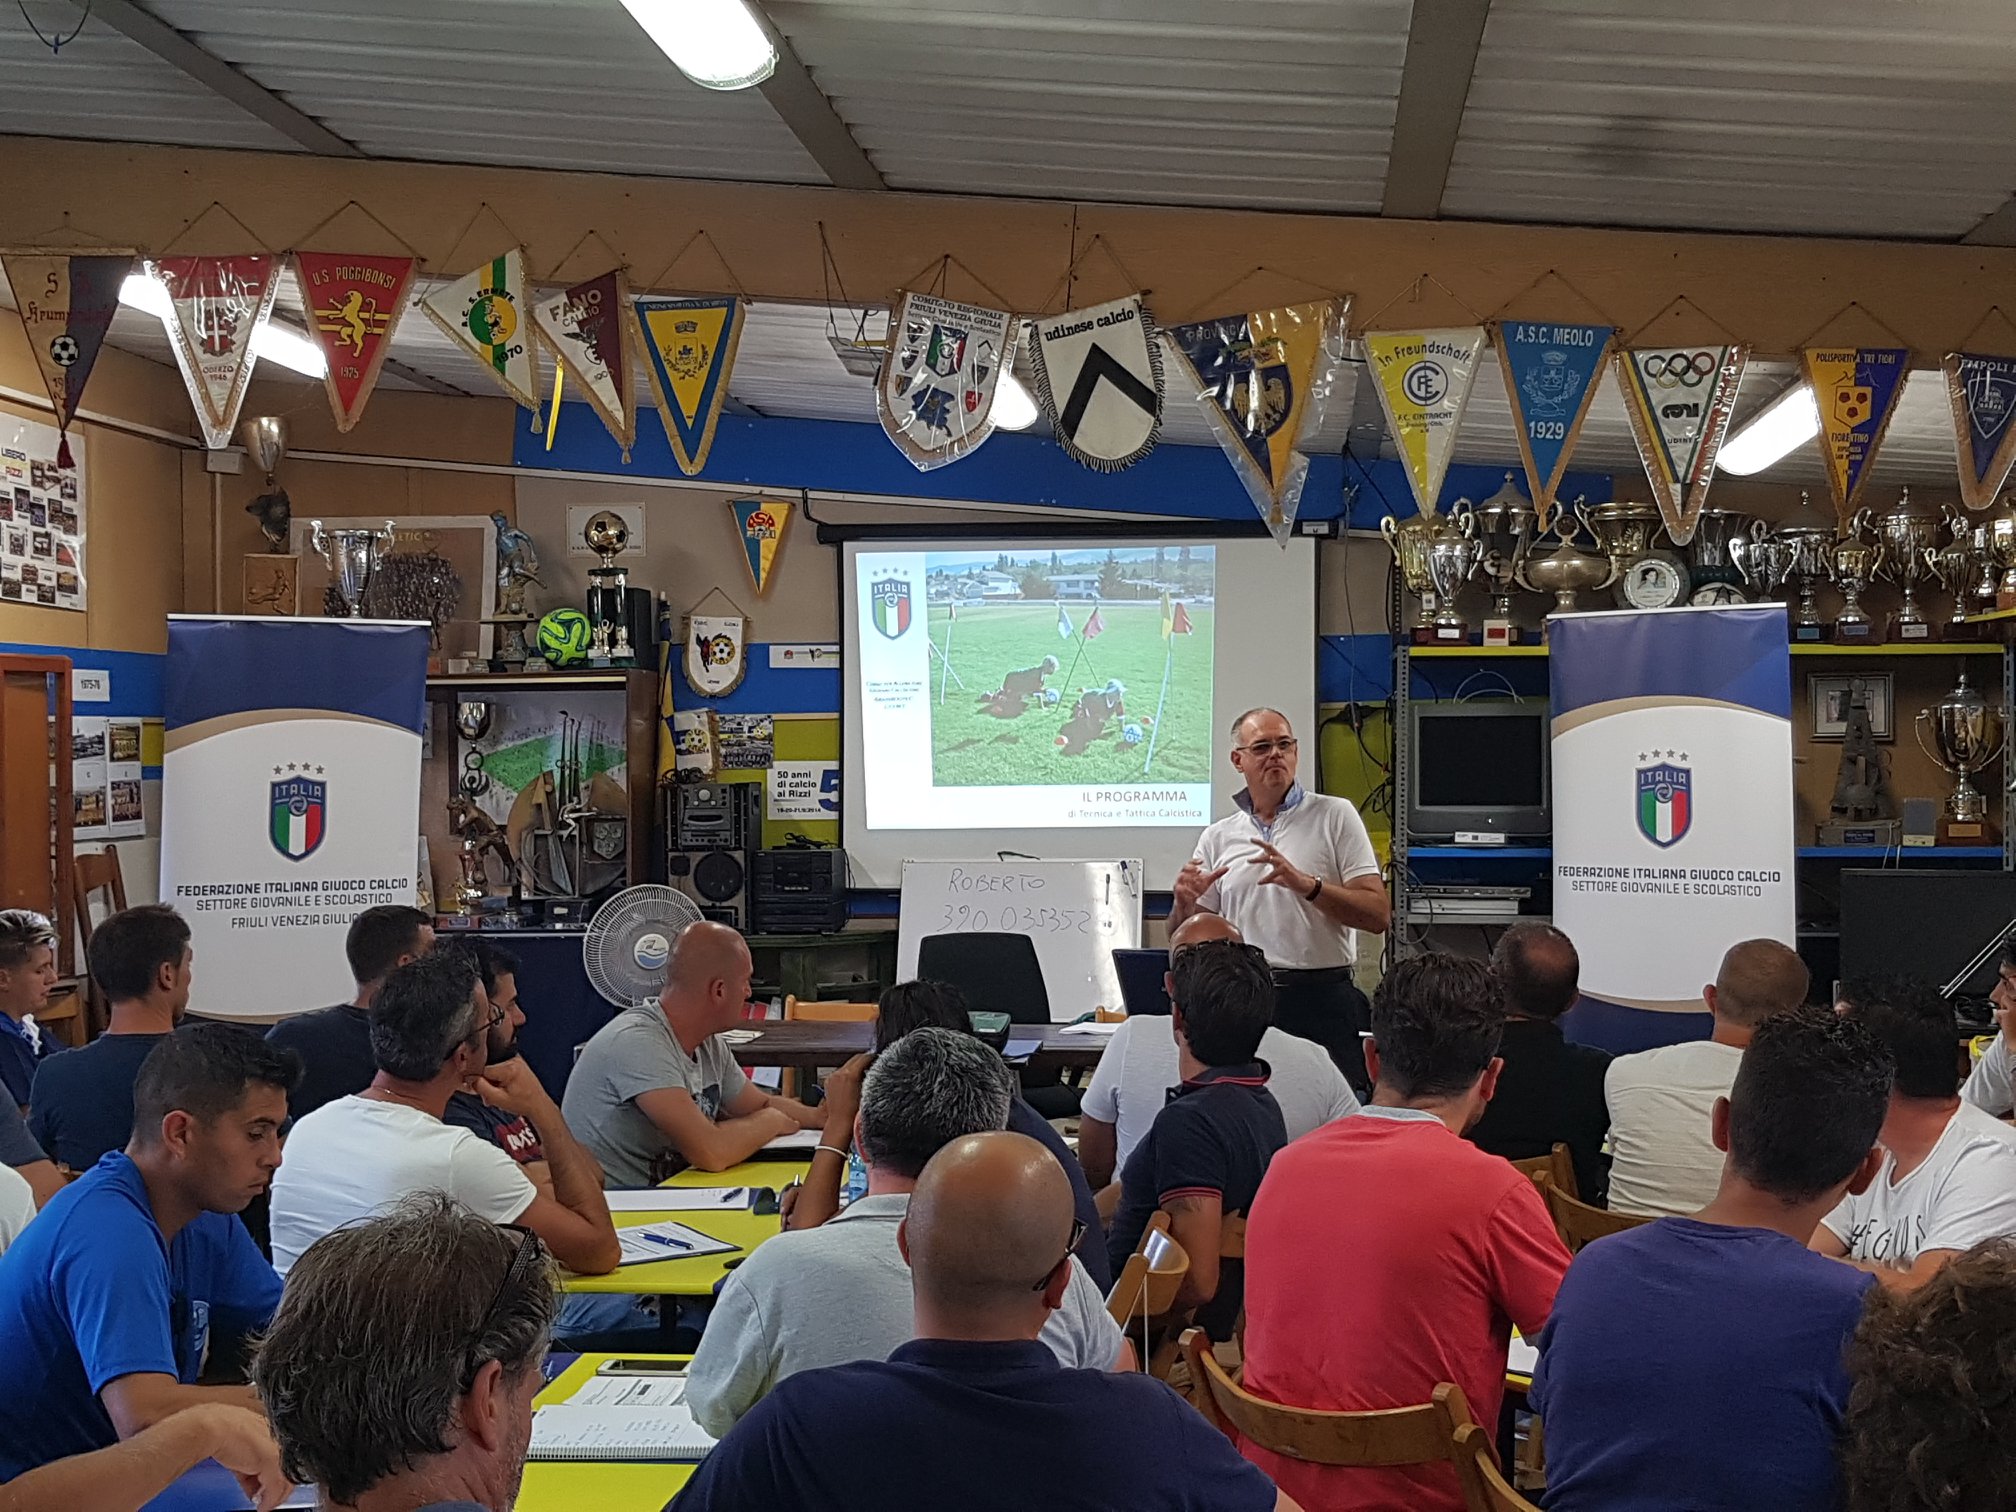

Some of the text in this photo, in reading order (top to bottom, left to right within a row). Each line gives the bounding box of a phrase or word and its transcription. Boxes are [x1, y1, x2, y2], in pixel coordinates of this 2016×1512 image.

[336, 266, 396, 289] POGGIBONSI
[549, 289, 602, 322] FANO
[956, 301, 1004, 320] REGIONALE
[909, 302, 1002, 330] FRIULI VENEZIA GIULIA
[1044, 307, 1135, 342] udinese calcio
[1515, 326, 1594, 347] A.S.C. MEOLO
[494, 344, 523, 365] 1970
[1378, 341, 1470, 367] In Freundschaft
[1879, 353, 1896, 364] FIORI
[1962, 359, 2008, 372] EMPOLI
[1529, 420, 1565, 440] 1929
[873, 584, 908, 595] ITALIA
[777, 770, 811, 779] 50 anni
[1641, 771, 1686, 784] ITALIA
[275, 783, 322, 798] ITALIA
[777, 780, 817, 788] di calcio
[789, 790, 811, 798] Rizzi
[1082, 791, 1188, 803] IL PROGRAMMA
[1067, 809, 1077, 818] di
[1080, 809, 1113, 818] Tecnica
[1125, 809, 1156, 818] Tattica
[1158, 809, 1203, 818] Calcistica
[949, 868, 1046, 893] ROBERTO
[1558, 866, 1781, 883] FEDERAZIONE ITALIANA GIUOCO CALCIO
[177, 878, 408, 896] FEDERAZIONE ITALIANA GIUOCO CALCIO
[1572, 880, 1762, 897] SETTORE GIOVANILE E SCOLASTICO
[196, 893, 393, 911] SETTORE GIOVANILE E SCOLASTICO
[231, 917, 268, 929] FRIULI
[271, 914, 320, 927] VENEZIA
[937, 904, 989, 932] 390
